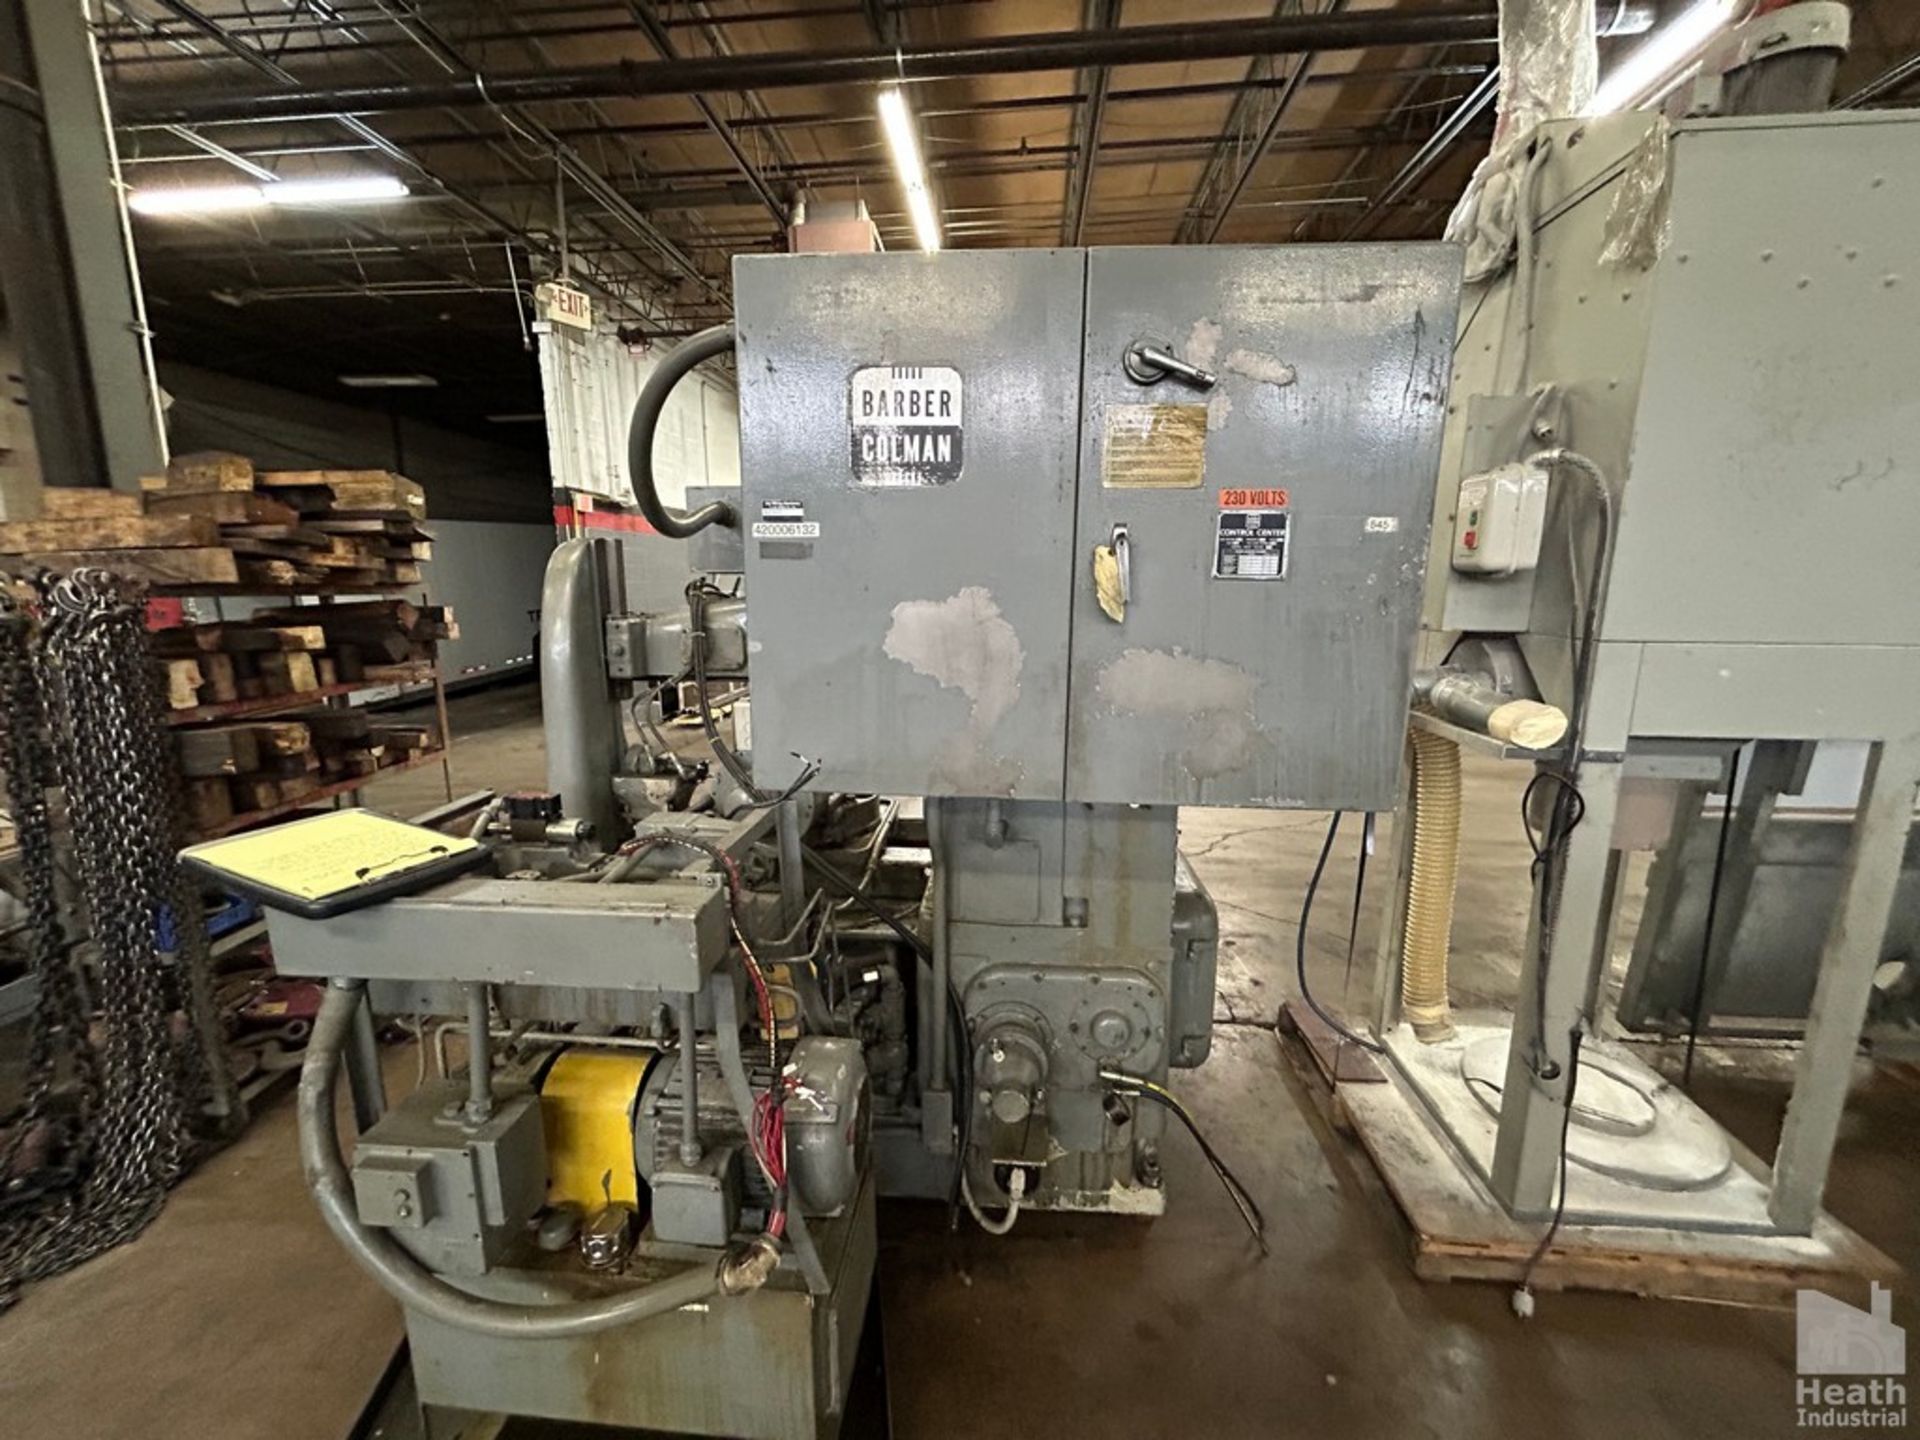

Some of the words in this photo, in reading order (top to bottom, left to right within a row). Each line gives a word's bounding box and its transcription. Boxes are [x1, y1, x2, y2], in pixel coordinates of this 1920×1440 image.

[558, 288, 584, 318] EXIT
[862, 389, 951, 417] BARBER
[861, 433, 952, 463] COLMAN
[1224, 491, 1246, 506] 230
[1250, 490, 1286, 506] VOLTS
[755, 524, 817, 535] 420006132
